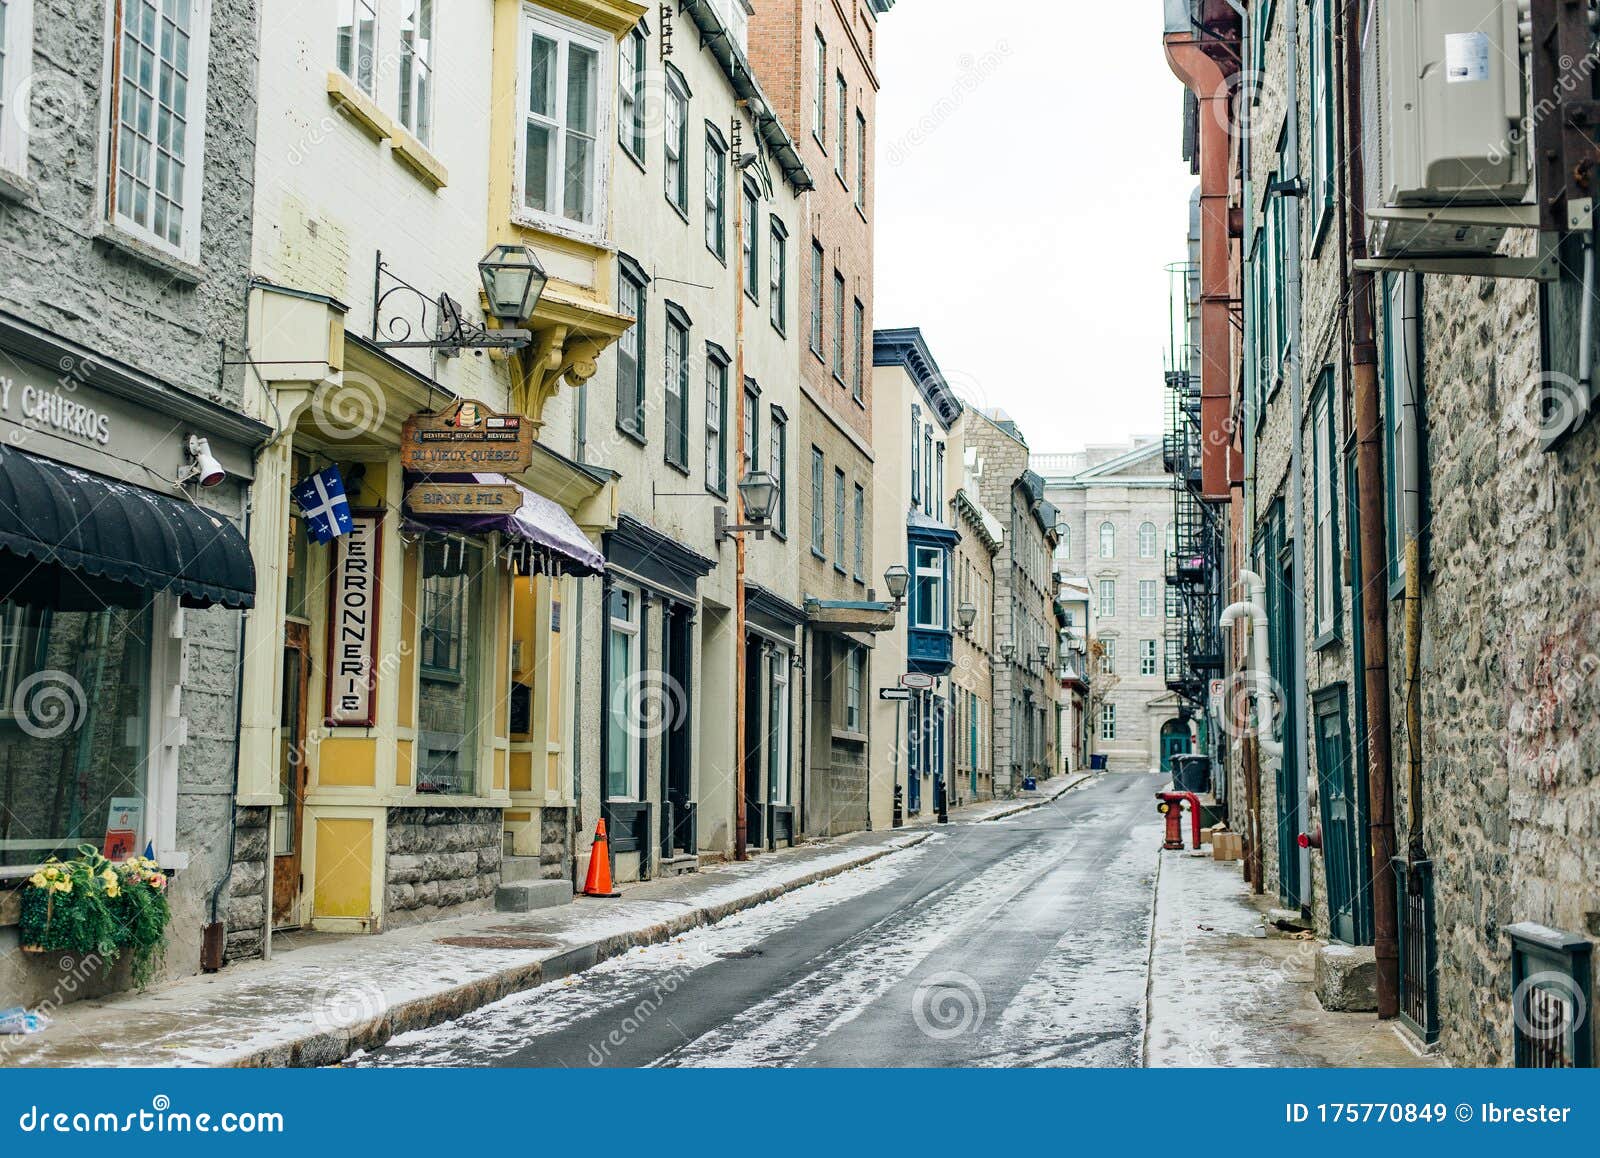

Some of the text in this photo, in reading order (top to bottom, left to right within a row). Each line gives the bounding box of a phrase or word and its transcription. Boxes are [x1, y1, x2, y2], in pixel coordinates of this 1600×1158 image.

[22, 385, 109, 443] CHURROS
[411, 449, 425, 460] DU
[423, 493, 504, 504] BIRON & FILS
[340, 524, 368, 711] FERRONNERIE
